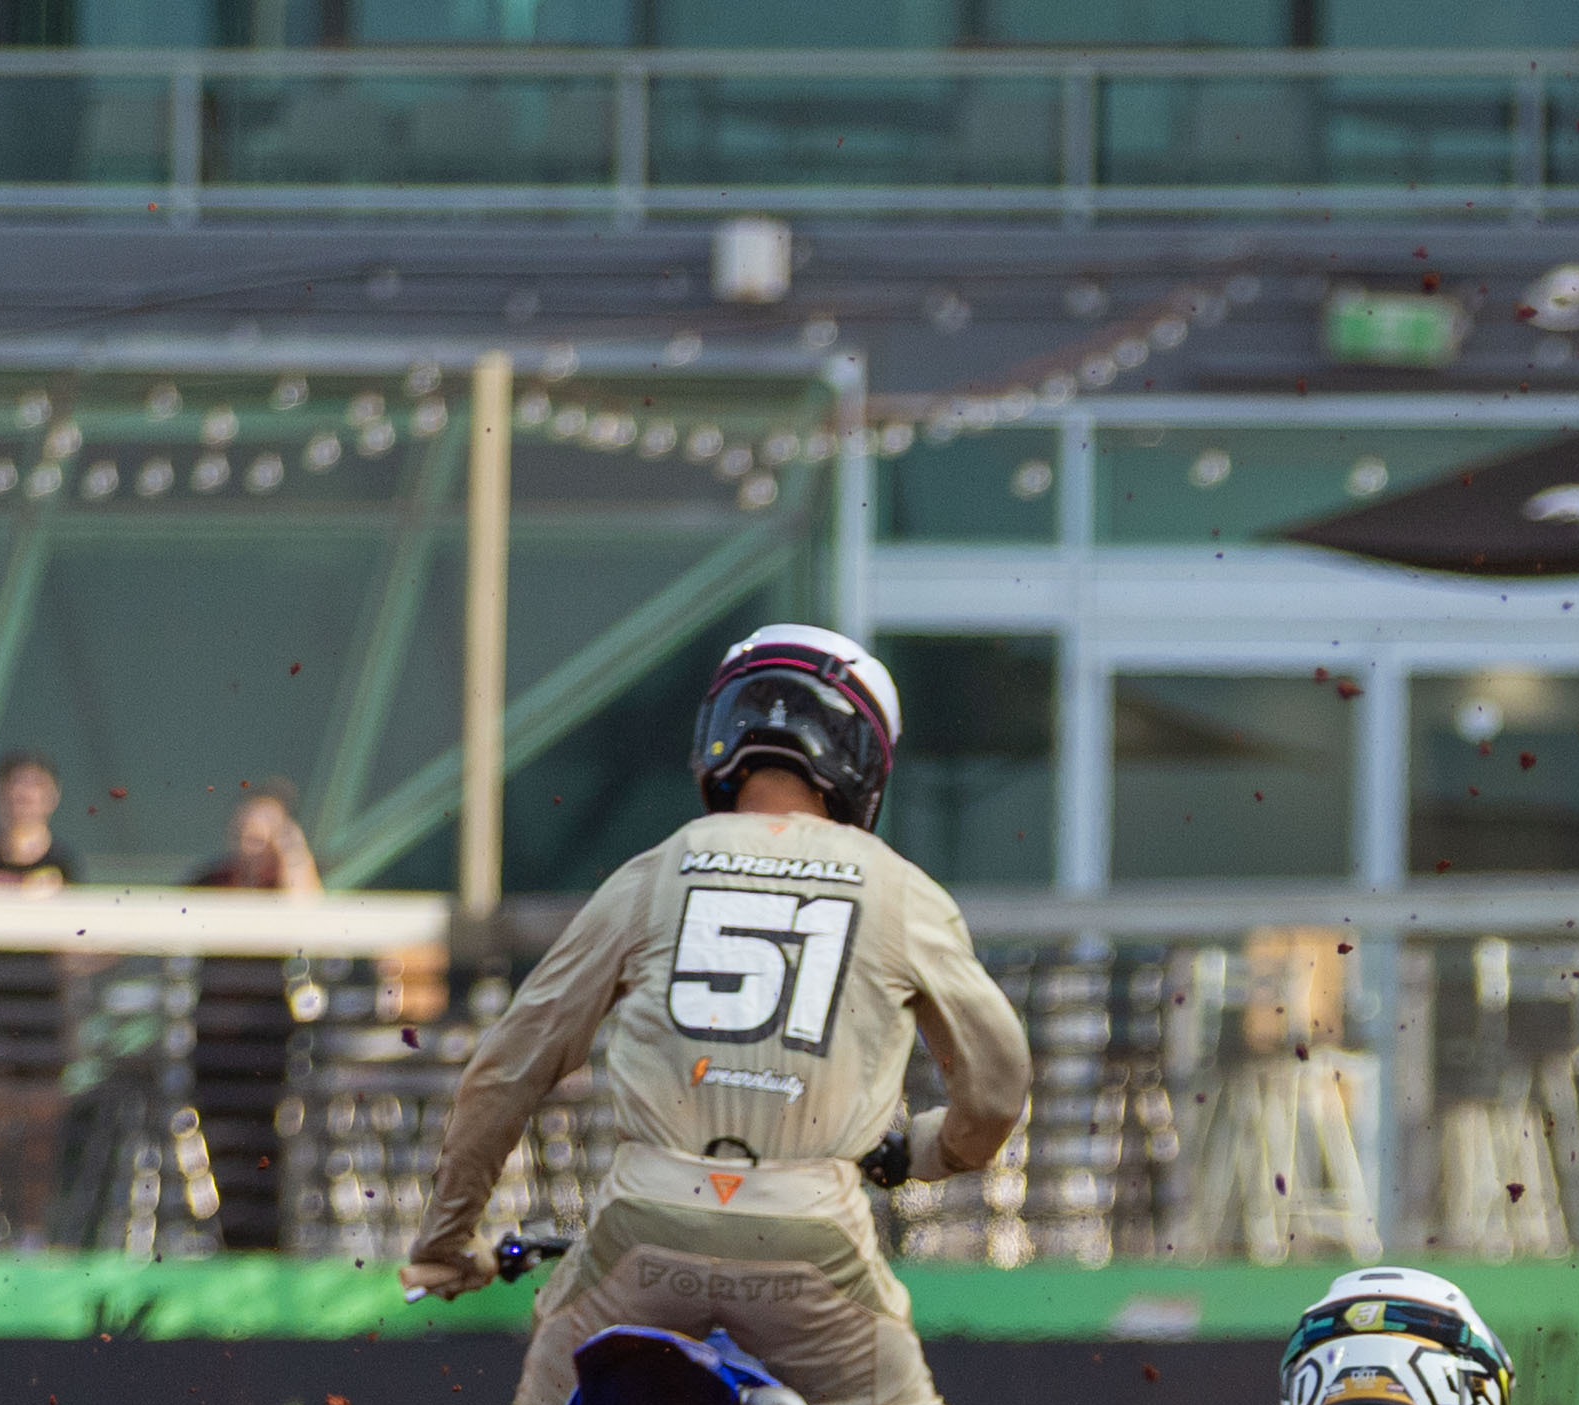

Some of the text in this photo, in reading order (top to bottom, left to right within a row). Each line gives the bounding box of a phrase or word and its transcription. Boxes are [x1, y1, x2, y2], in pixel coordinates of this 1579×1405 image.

[679, 852, 863, 884] MARSHALL
[669, 887, 860, 1056] 51
[639, 1264, 807, 1303] FORTH
